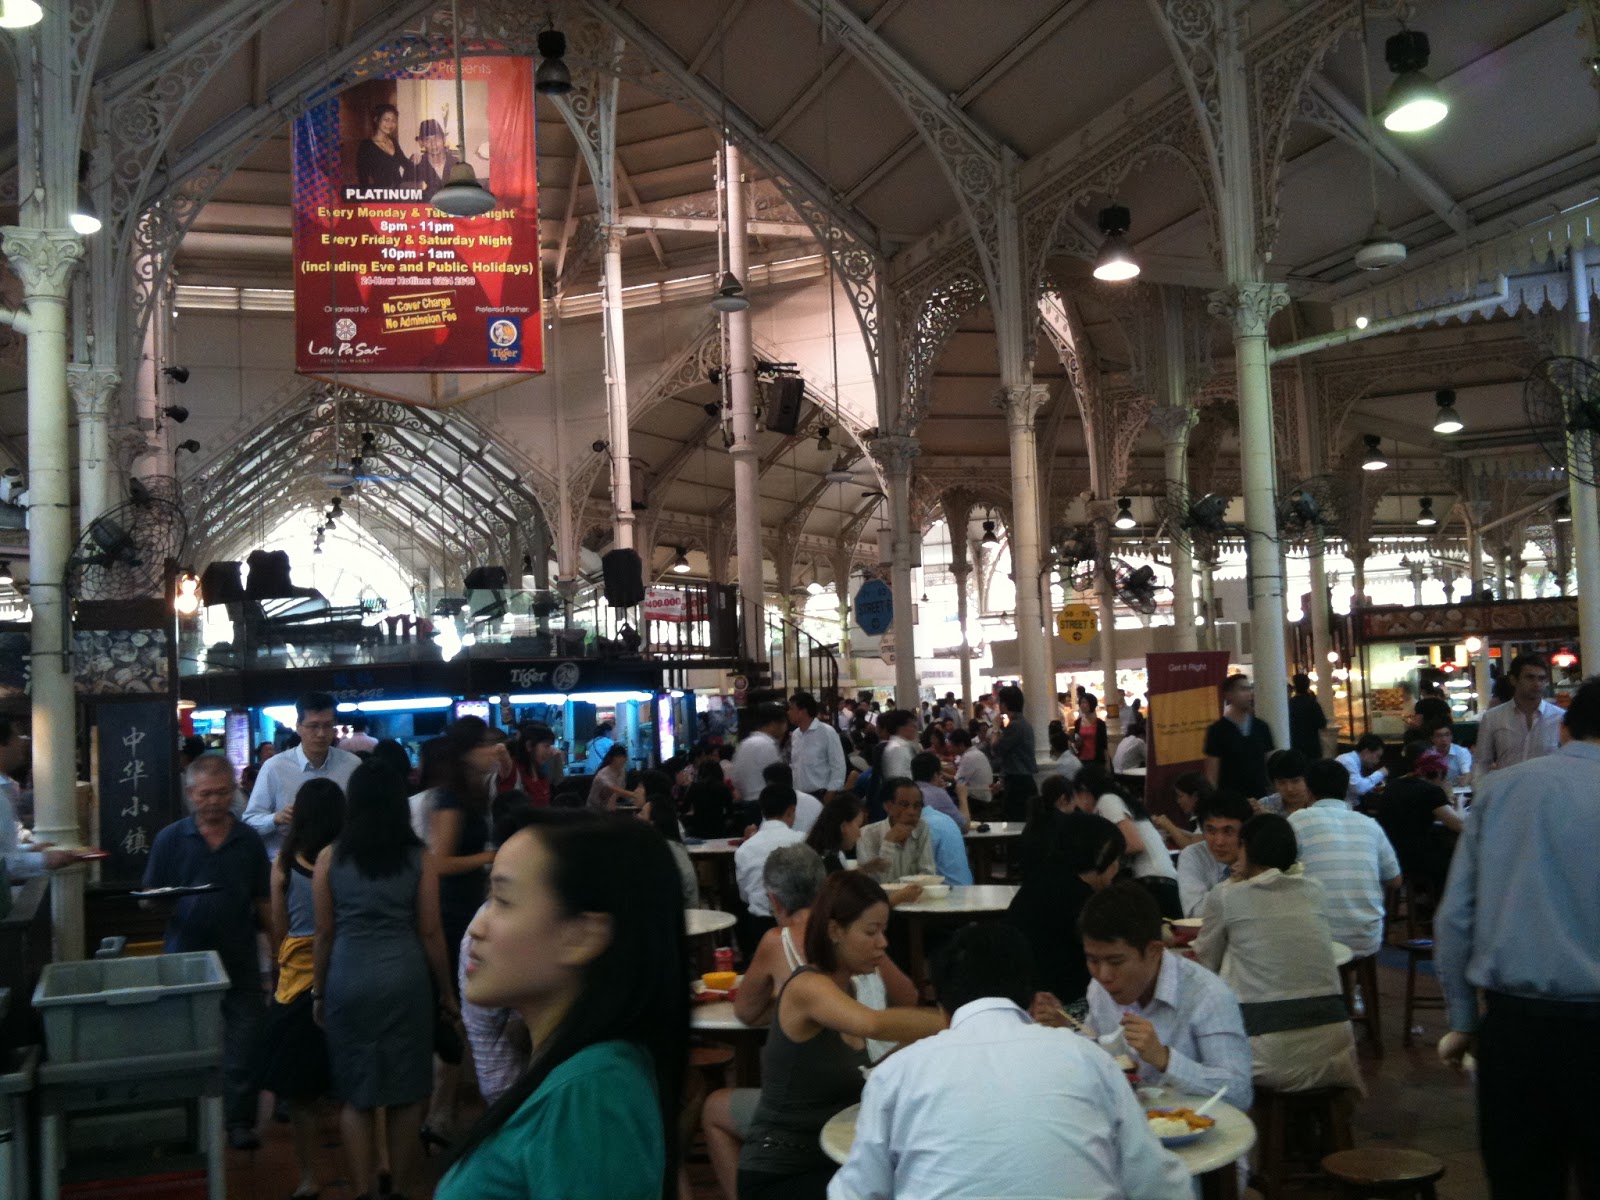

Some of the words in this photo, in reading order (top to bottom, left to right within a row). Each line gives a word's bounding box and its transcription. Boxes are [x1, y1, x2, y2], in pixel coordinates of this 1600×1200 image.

[346, 189, 423, 201] PLATINUM
[317, 207, 354, 220] Every
[358, 207, 407, 220] Monday
[411, 208, 420, 218] &
[380, 221, 408, 232] 8pm
[419, 221, 454, 232] 11pm
[361, 235, 401, 248] Friday
[405, 235, 414, 245] &
[419, 235, 475, 248] Saturday
[479, 235, 513, 248] Night
[381, 248, 416, 261] 10pm
[428, 248, 455, 259] 1am
[371, 261, 395, 272] Eve
[399, 261, 424, 272] and
[428, 261, 468, 273] Public
[473, 261, 534, 274] Holidays)
[383, 302, 396, 314] No
[397, 301, 421, 312] Cover
[422, 297, 451, 309] Charge
[386, 318, 399, 329] No
[400, 313, 441, 327] Admission
[442, 311, 457, 322] Fee
[308, 340, 335, 355] Lau
[338, 342, 353, 356] Pa
[355, 342, 387, 357] Sat
[490, 348, 518, 361] Tiger
[1060, 620, 1088, 629] STREET
[510, 667, 548, 688] Tiger
[320, 688, 384, 700] VERAGE
[119, 726, 150, 855] 中华小镇
